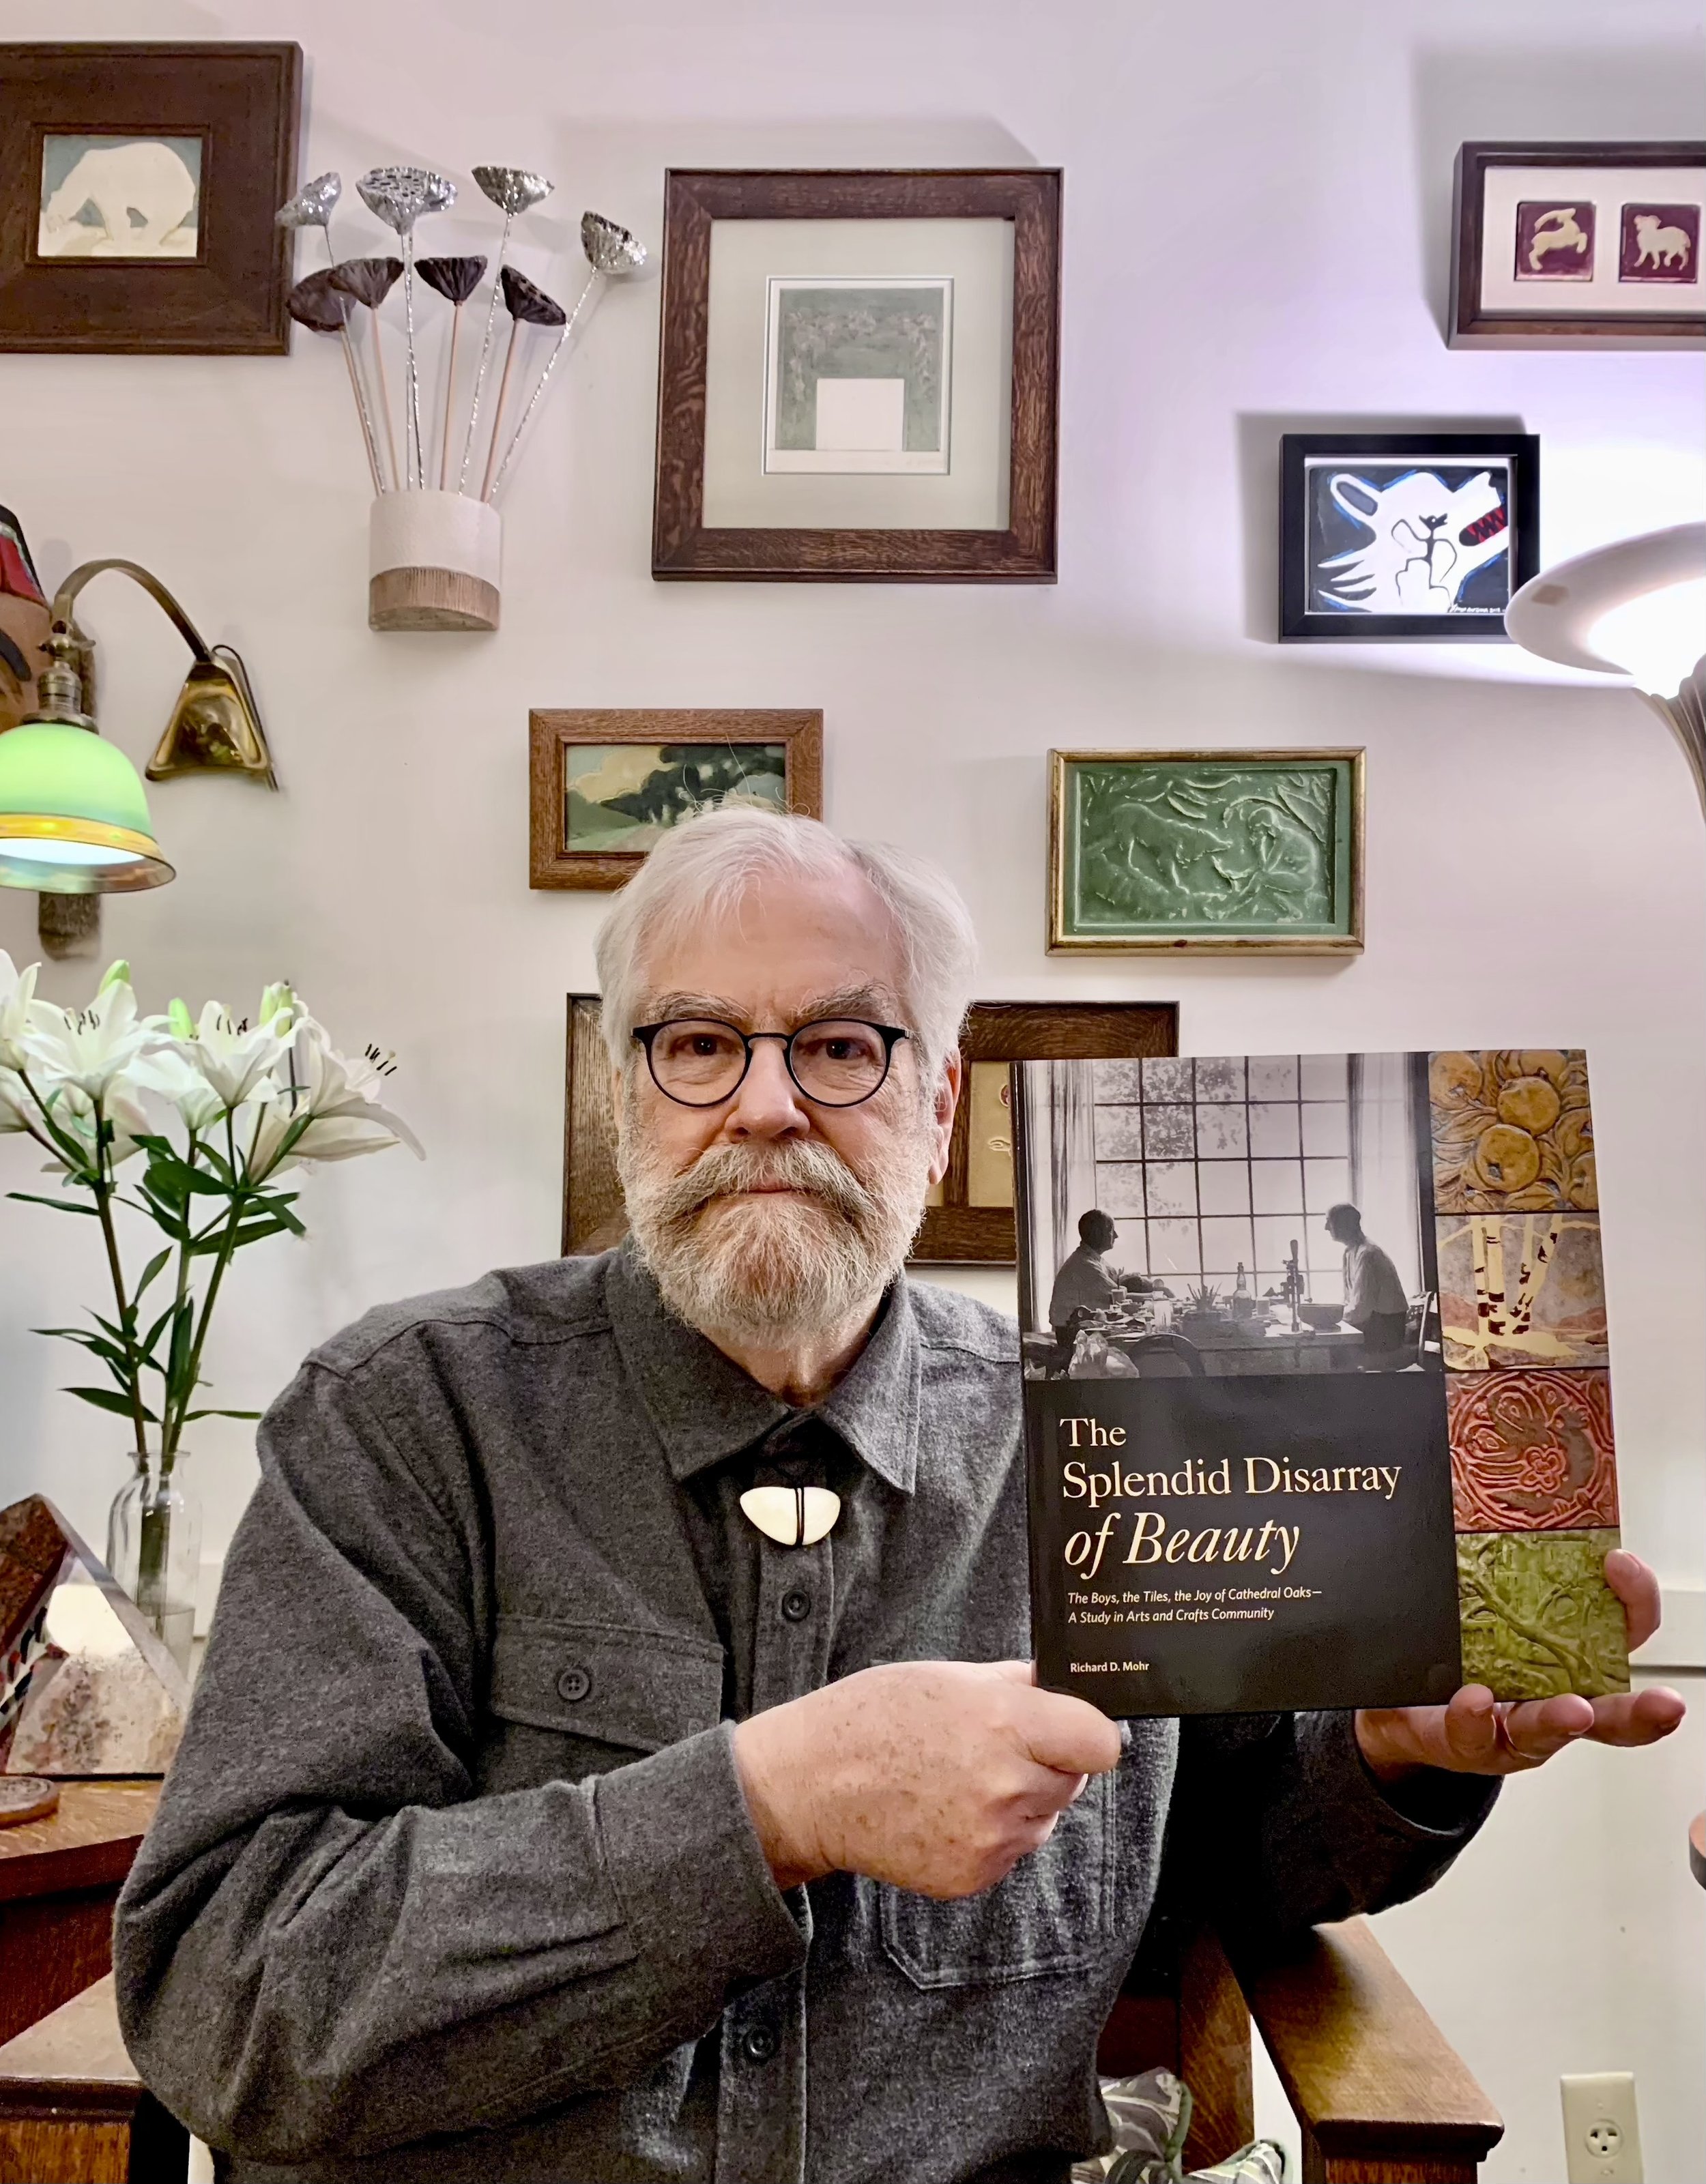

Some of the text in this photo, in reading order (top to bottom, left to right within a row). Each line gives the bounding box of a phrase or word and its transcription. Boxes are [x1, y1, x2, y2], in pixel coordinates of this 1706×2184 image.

[1060, 1418, 1126, 1446] The
[1063, 1456, 1402, 1508] Splendid Disarray
[1064, 1512, 1300, 1580] of Beauty
[1068, 1592, 1088, 1604] The
[1090, 1592, 1120, 1606] Boys,
[1122, 1590, 1140, 1603] the
[1143, 1590, 1171, 1603] Tiles,
[1174, 1589, 1192, 1602] the
[1194, 1590, 1213, 1603] Joy
[1215, 1588, 1226, 1603] of
[1228, 1586, 1282, 1601] Cathedral
[1068, 1607, 1275, 1625] A Study in Arts and Crafts Community
[1070, 1661, 1150, 1673] Richard D. Mohr
